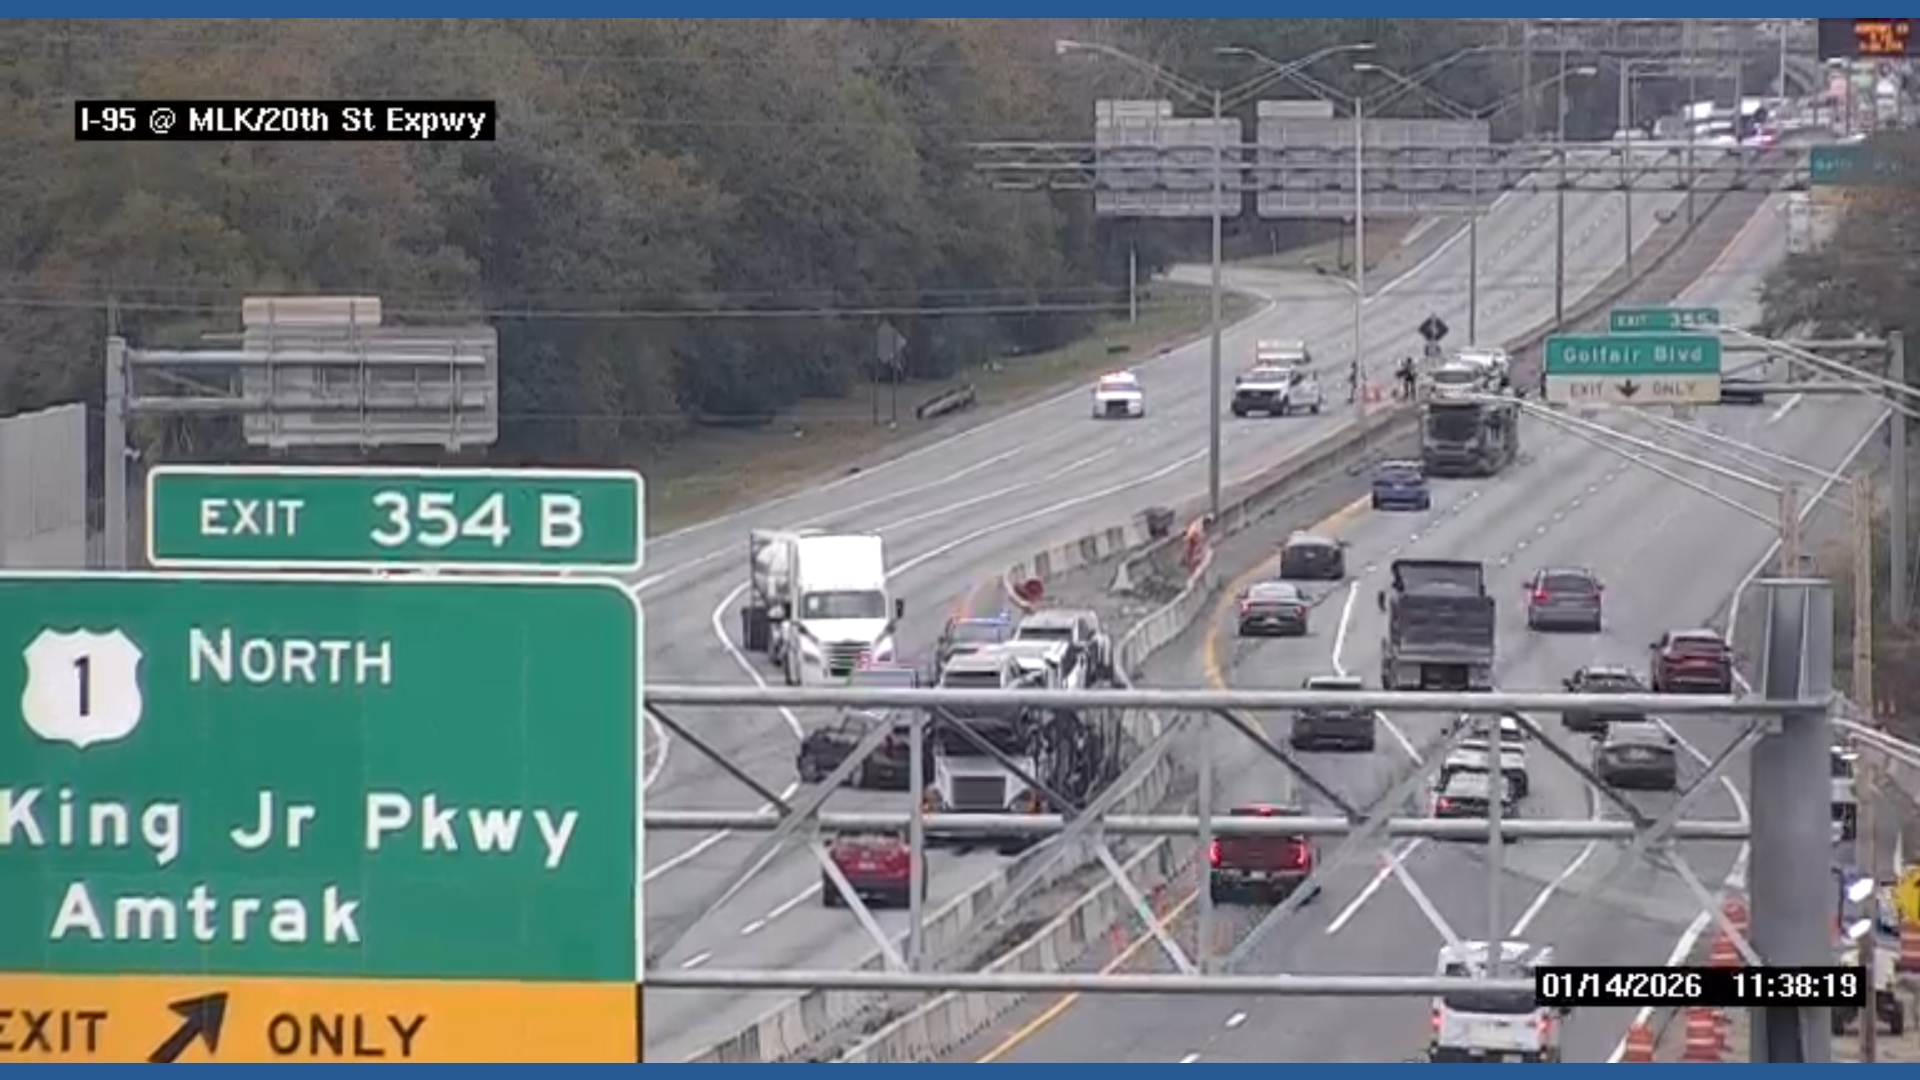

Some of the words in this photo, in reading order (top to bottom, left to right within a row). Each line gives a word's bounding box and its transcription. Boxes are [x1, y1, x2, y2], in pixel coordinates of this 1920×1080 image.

[1618, 314, 1646, 327] EXIT
[1563, 344, 1642, 364] Golfair
[1654, 344, 1703, 363] Blvd
[1570, 381, 1604, 398] EXIT
[1653, 381, 1697, 397] ONLY
[200, 498, 304, 536] EXIT
[371, 492, 511, 547] 354
[540, 494, 583, 548] B
[73, 655, 90, 717] 1
[0, 788, 179, 866] King
[230, 790, 316, 849] Jr
[366, 793, 578, 868] Pkwy
[50, 882, 361, 943] Amtrak
[267, 1012, 426, 1058] ONLY
